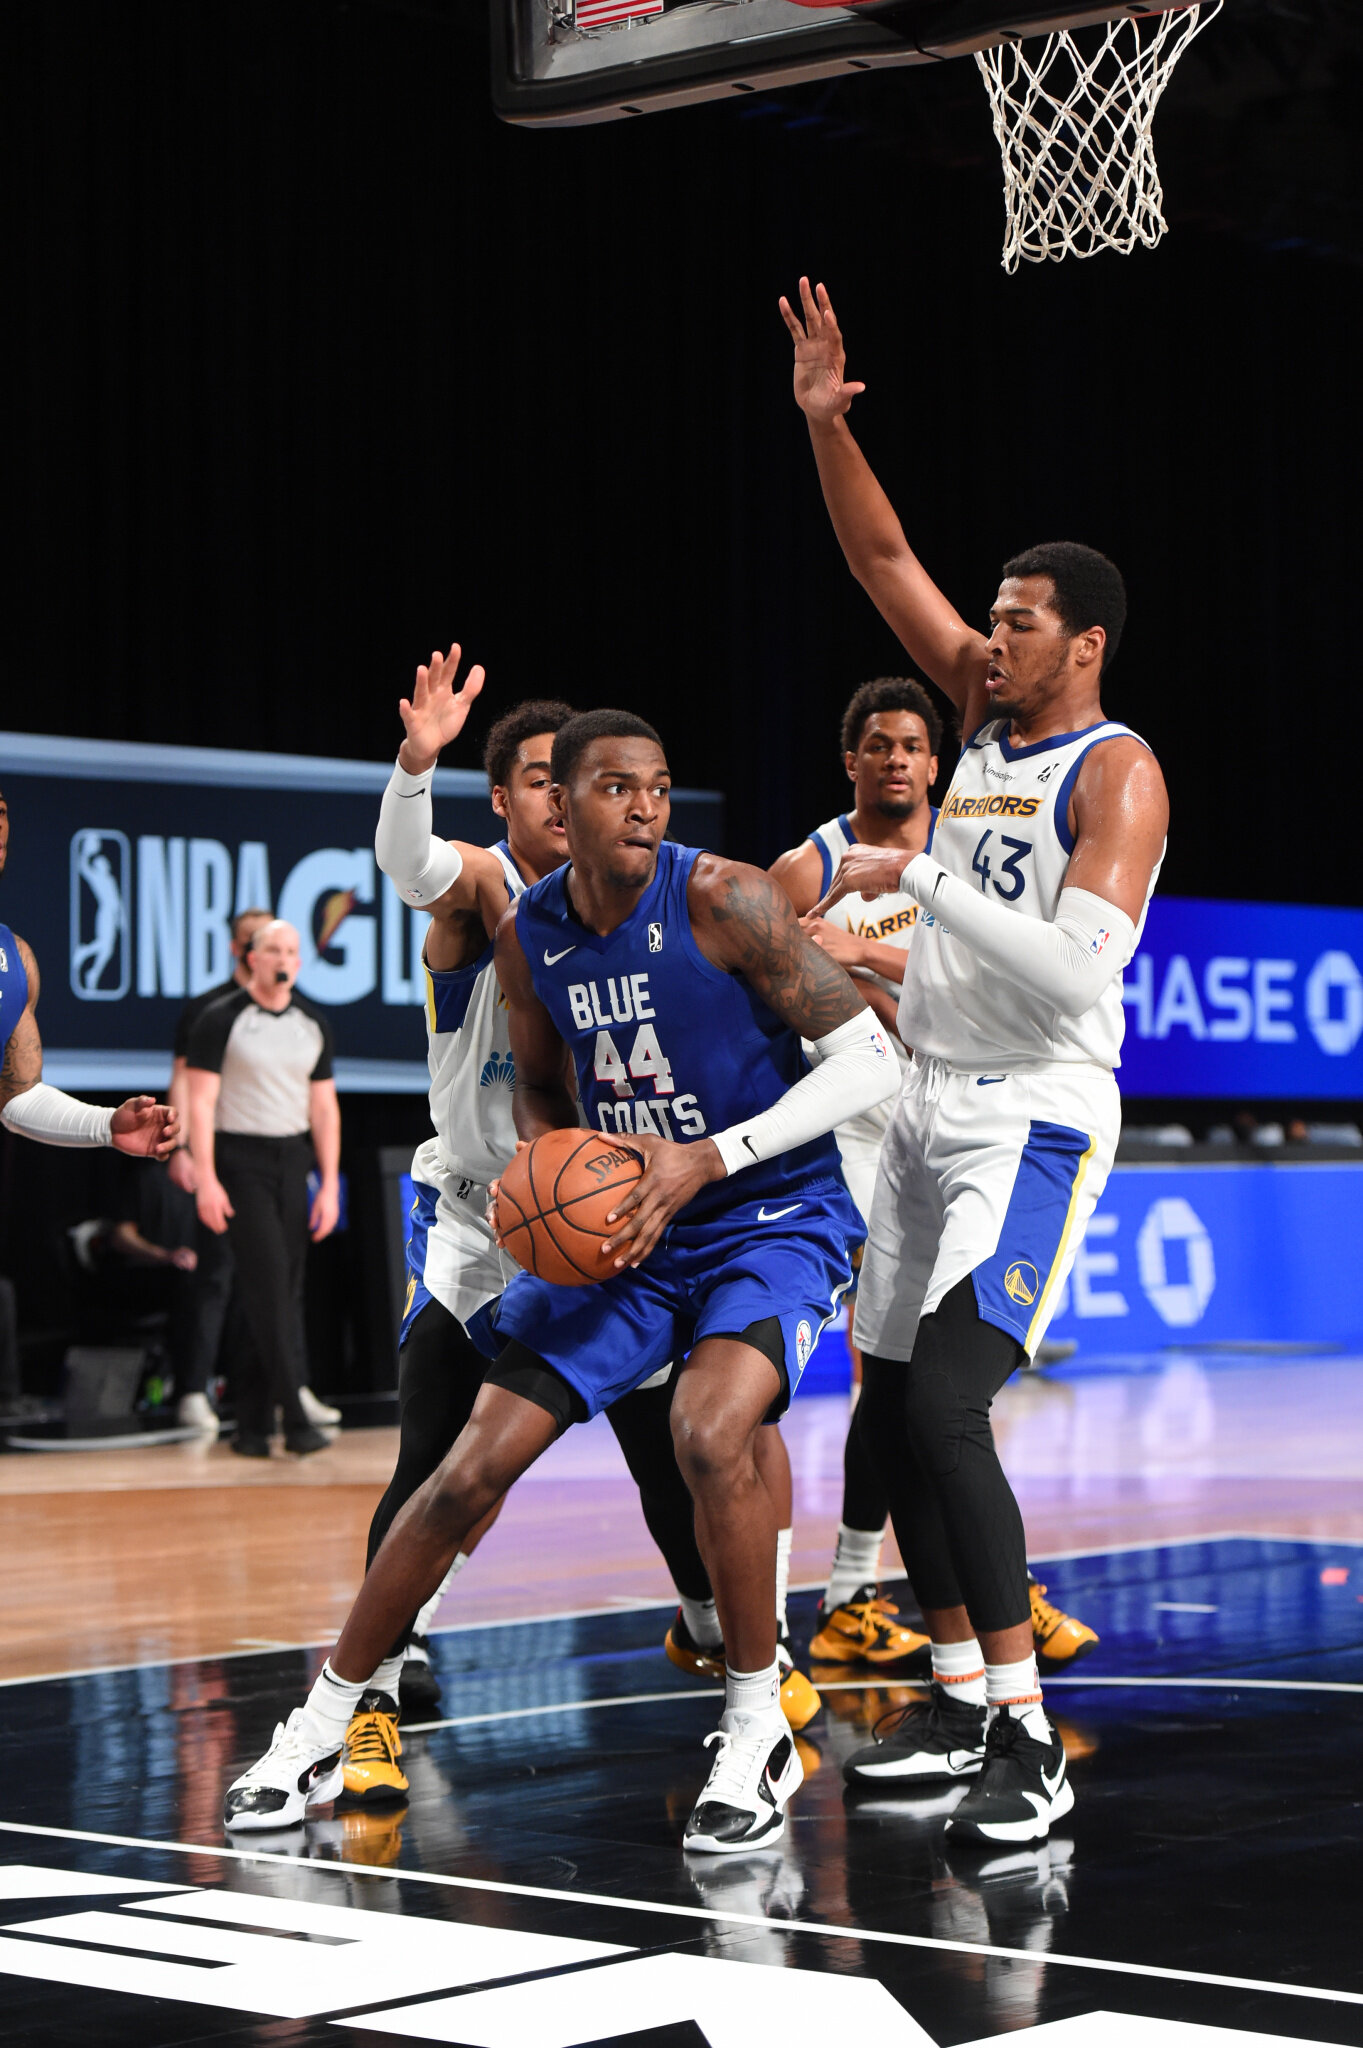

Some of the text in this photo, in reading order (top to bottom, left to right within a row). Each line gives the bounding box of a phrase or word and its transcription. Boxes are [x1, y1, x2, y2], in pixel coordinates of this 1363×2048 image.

[936, 783, 1044, 827] WARRIORS
[971, 829, 1033, 901] 43
[568, 972, 656, 1030] BLUE
[593, 1023, 674, 1098] 44
[597, 1093, 707, 1142] COATS
[585, 1148, 634, 1184] SPAL
